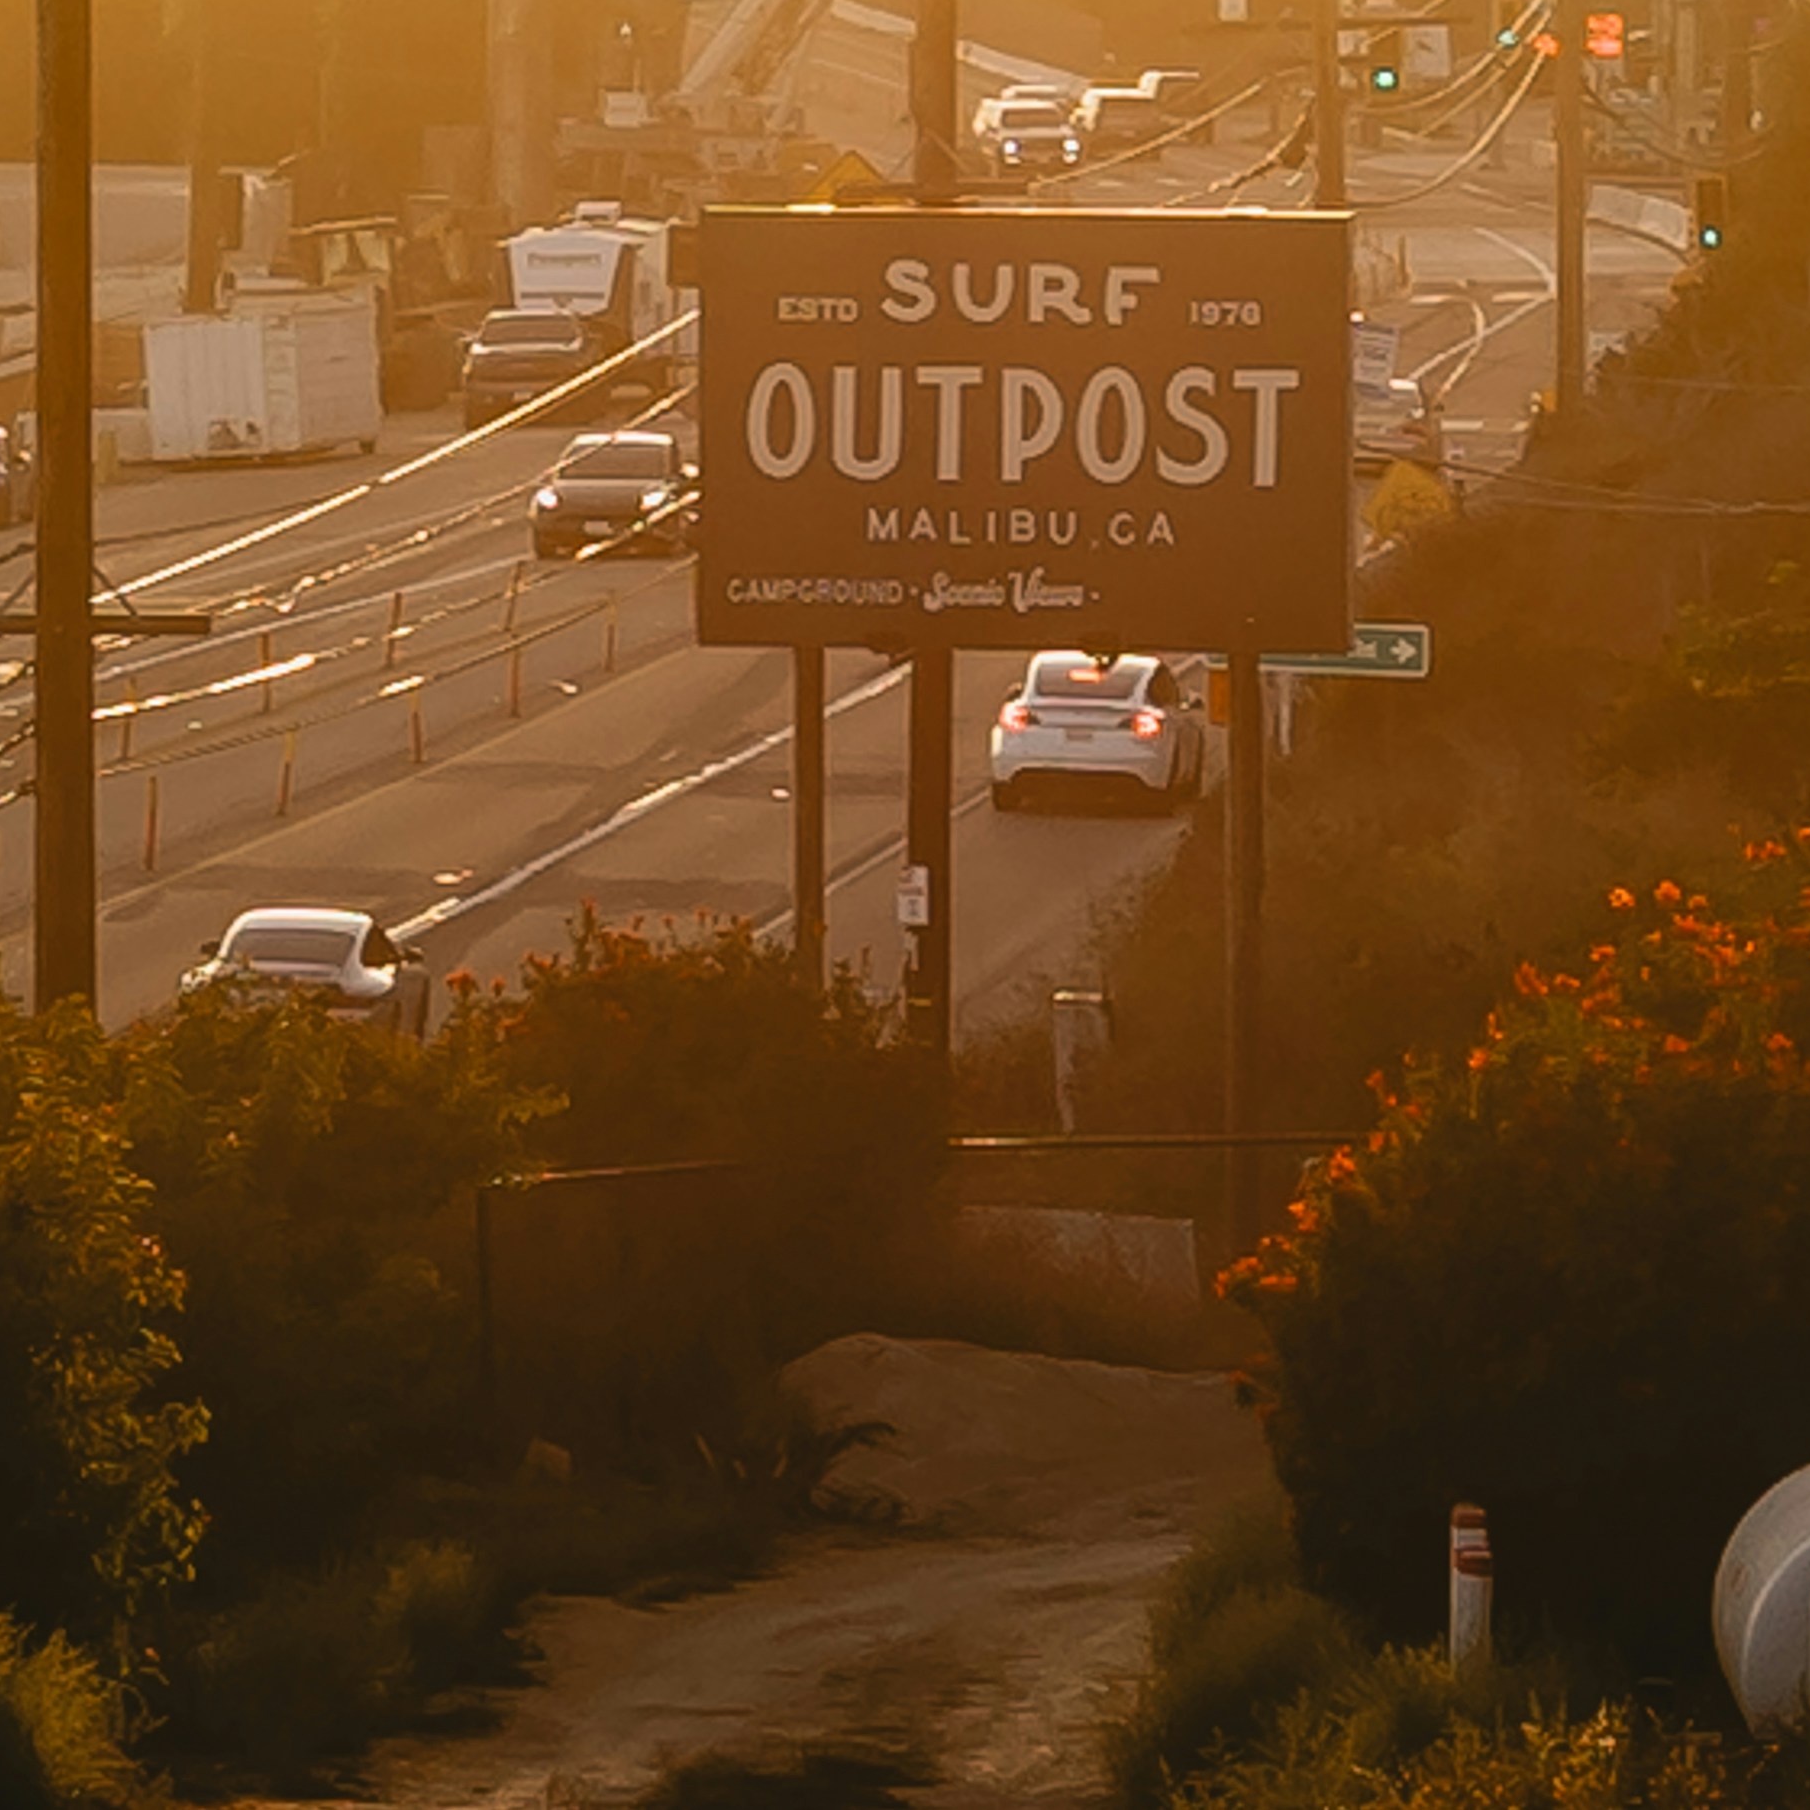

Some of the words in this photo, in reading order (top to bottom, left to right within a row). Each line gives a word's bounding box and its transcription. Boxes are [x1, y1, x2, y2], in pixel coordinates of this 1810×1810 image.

[778, 297, 858, 323] ESTD
[881, 260, 1159, 325] SURF
[746, 363, 1299, 488] OUTPOST
[1108, 512, 1174, 545] CA
[727, 578, 904, 605] CAMPGROUND
